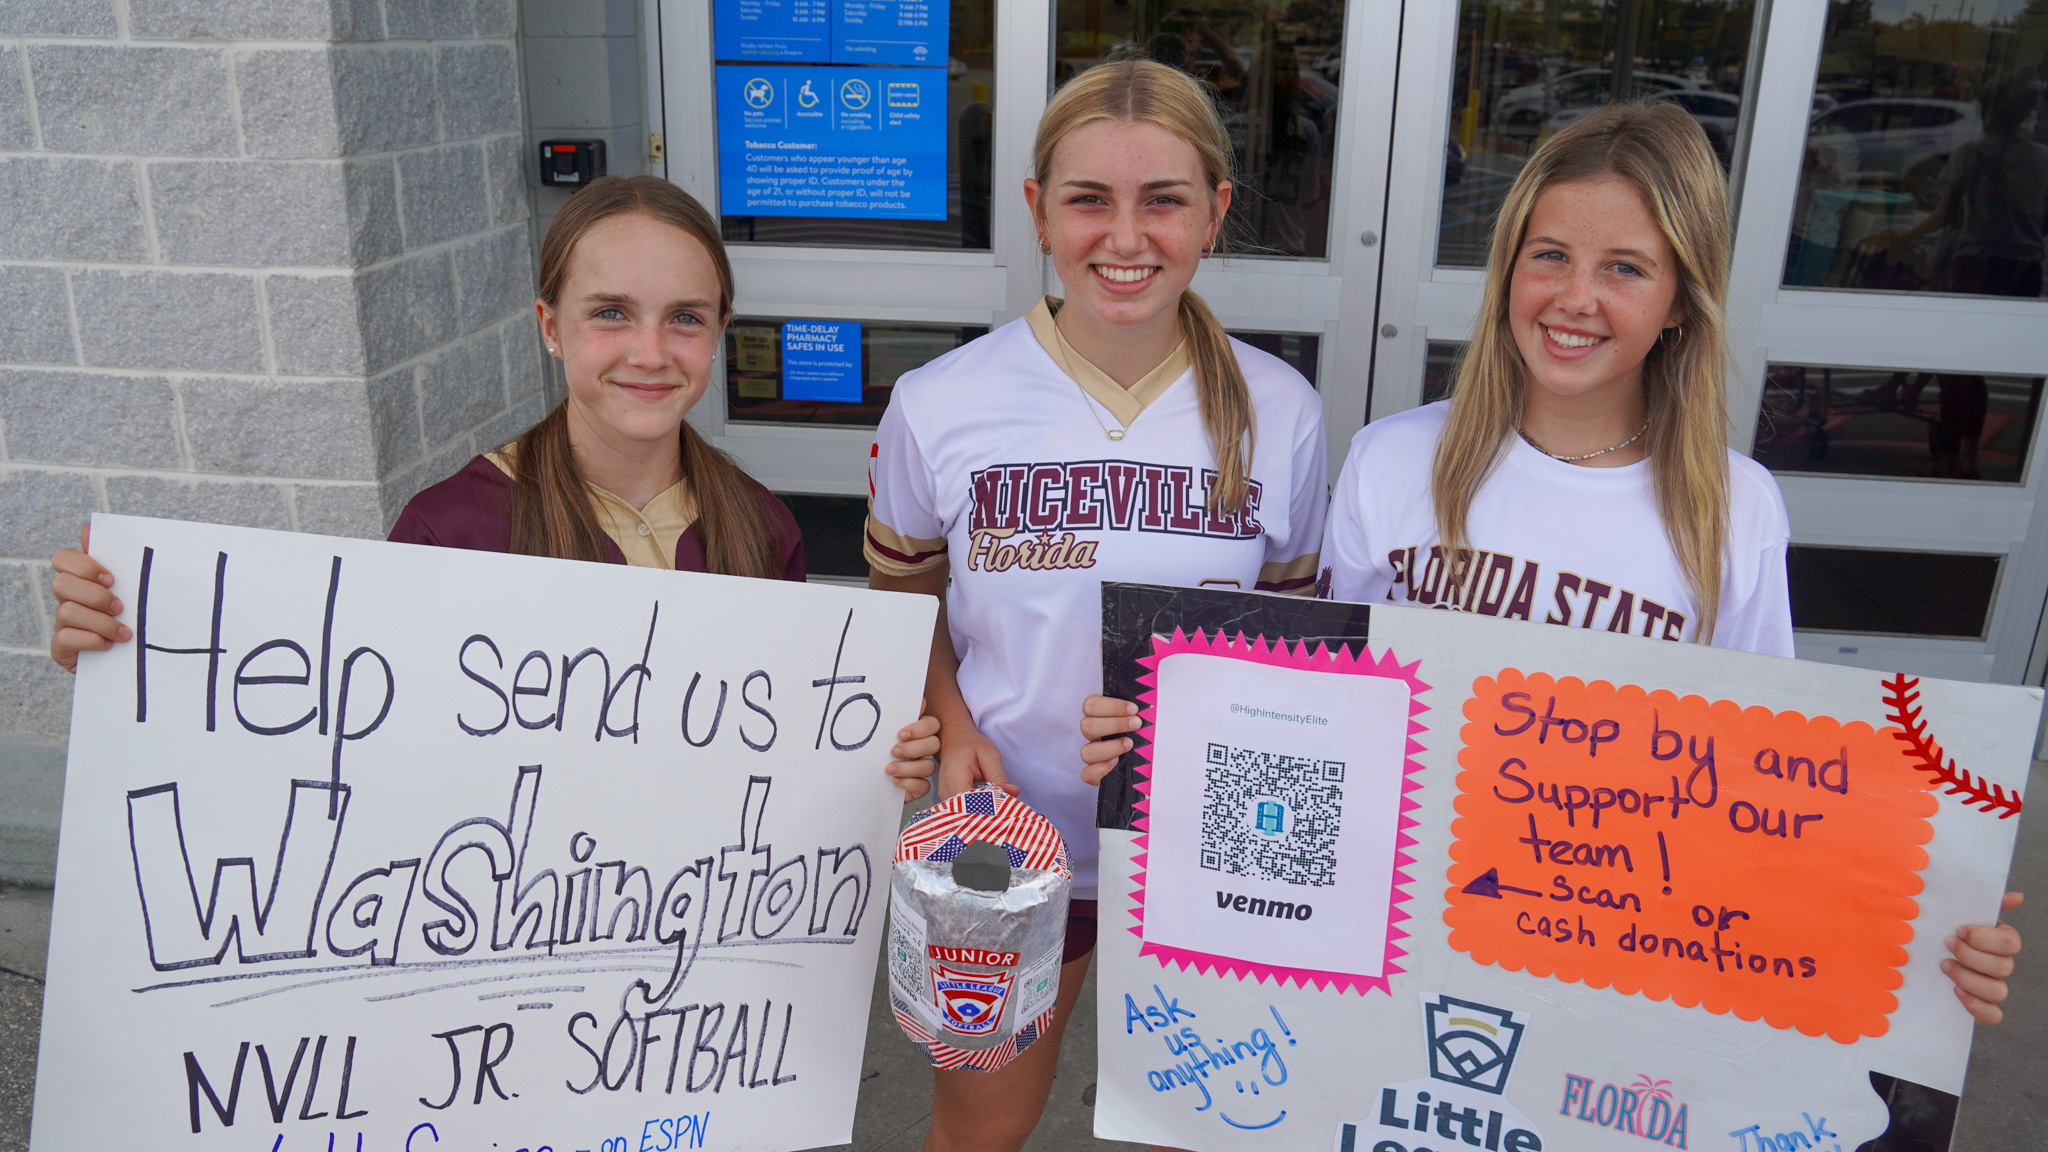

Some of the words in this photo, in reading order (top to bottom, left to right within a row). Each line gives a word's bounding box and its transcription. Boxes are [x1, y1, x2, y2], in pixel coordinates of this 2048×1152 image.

[745, 140, 776, 148] Tobacco
[777, 141, 817, 149] Customer:
[745, 153, 788, 162] Customers
[790, 154, 807, 162] who
[808, 155, 835, 164] appear
[837, 156, 870, 165] younger
[872, 155, 890, 163] than
[891, 157, 907, 166] age
[774, 165, 784, 173] be
[785, 165, 808, 173] asked
[820, 165, 850, 175] provide
[852, 166, 874, 176] proof
[876, 166, 885, 174] of
[886, 168, 901, 177] age
[903, 168, 913, 177] by
[746, 176, 778, 186] showing
[780, 178, 807, 186] proper
[808, 177, 820, 185] ID.
[821, 177, 865, 186] Customers
[866, 178, 890, 186] under
[891, 178, 905, 187] the
[746, 188, 761, 197] age
[762, 187, 771, 195] of
[773, 187, 783, 196] 21,
[785, 188, 794, 196] or
[795, 187, 826, 196] without
[827, 189, 854, 198] proper
[856, 188, 868, 197] ID,
[869, 188, 883, 197] will
[884, 190, 898, 198] not
[900, 189, 911, 198] be
[747, 198, 786, 207] permitted
[787, 199, 797, 207] to
[798, 199, 834, 208] purchase
[835, 200, 868, 208] tobacco
[869, 200, 907, 209] products.
[786, 324, 840, 334] TIME-DELAY
[786, 333, 837, 343] PHARMACY
[786, 342, 813, 351] SAFES
[815, 343, 825, 351] IN
[827, 343, 844, 352] USE
[969, 459, 1265, 541] NICEVILLE
[968, 525, 1098, 572] Florida
[1386, 543, 1541, 621] FLORIDA
[137, 547, 394, 819] Help
[457, 600, 659, 744] send
[681, 670, 777, 752] us
[812, 608, 881, 751] to
[1230, 703, 1328, 726] @HighIntensityElite
[1494, 691, 1620, 757] Stop
[1651, 707, 1718, 808] by
[1753, 745, 1849, 795] and
[1493, 757, 1690, 828] Support
[1729, 800, 1824, 839] our
[1216, 891, 1313, 921] venmo
[1692, 904, 1750, 931] or
[935, 947, 1015, 965] JUNIOR
[1516, 910, 1596, 948] cash
[1618, 922, 1817, 979] donations
[939, 981, 967, 989] LITTLE
[970, 983, 1004, 994] LEAGUE
[946, 1015, 994, 1030] SOFTBALL
[1124, 984, 1196, 1034] Ask
[1163, 1027, 1201, 1056] us
[183, 1034, 368, 1133] NVLL
[419, 1022, 519, 1109] JR.
[565, 998, 796, 1095] SOFTBALL
[1147, 1004, 1297, 1111] anything!
[1379, 1087, 1542, 1152] Little
[1559, 1073, 1688, 1150] FLORIDA
[639, 1111, 710, 1152] ESPN
[1728, 1111, 1837, 1152] Thank
